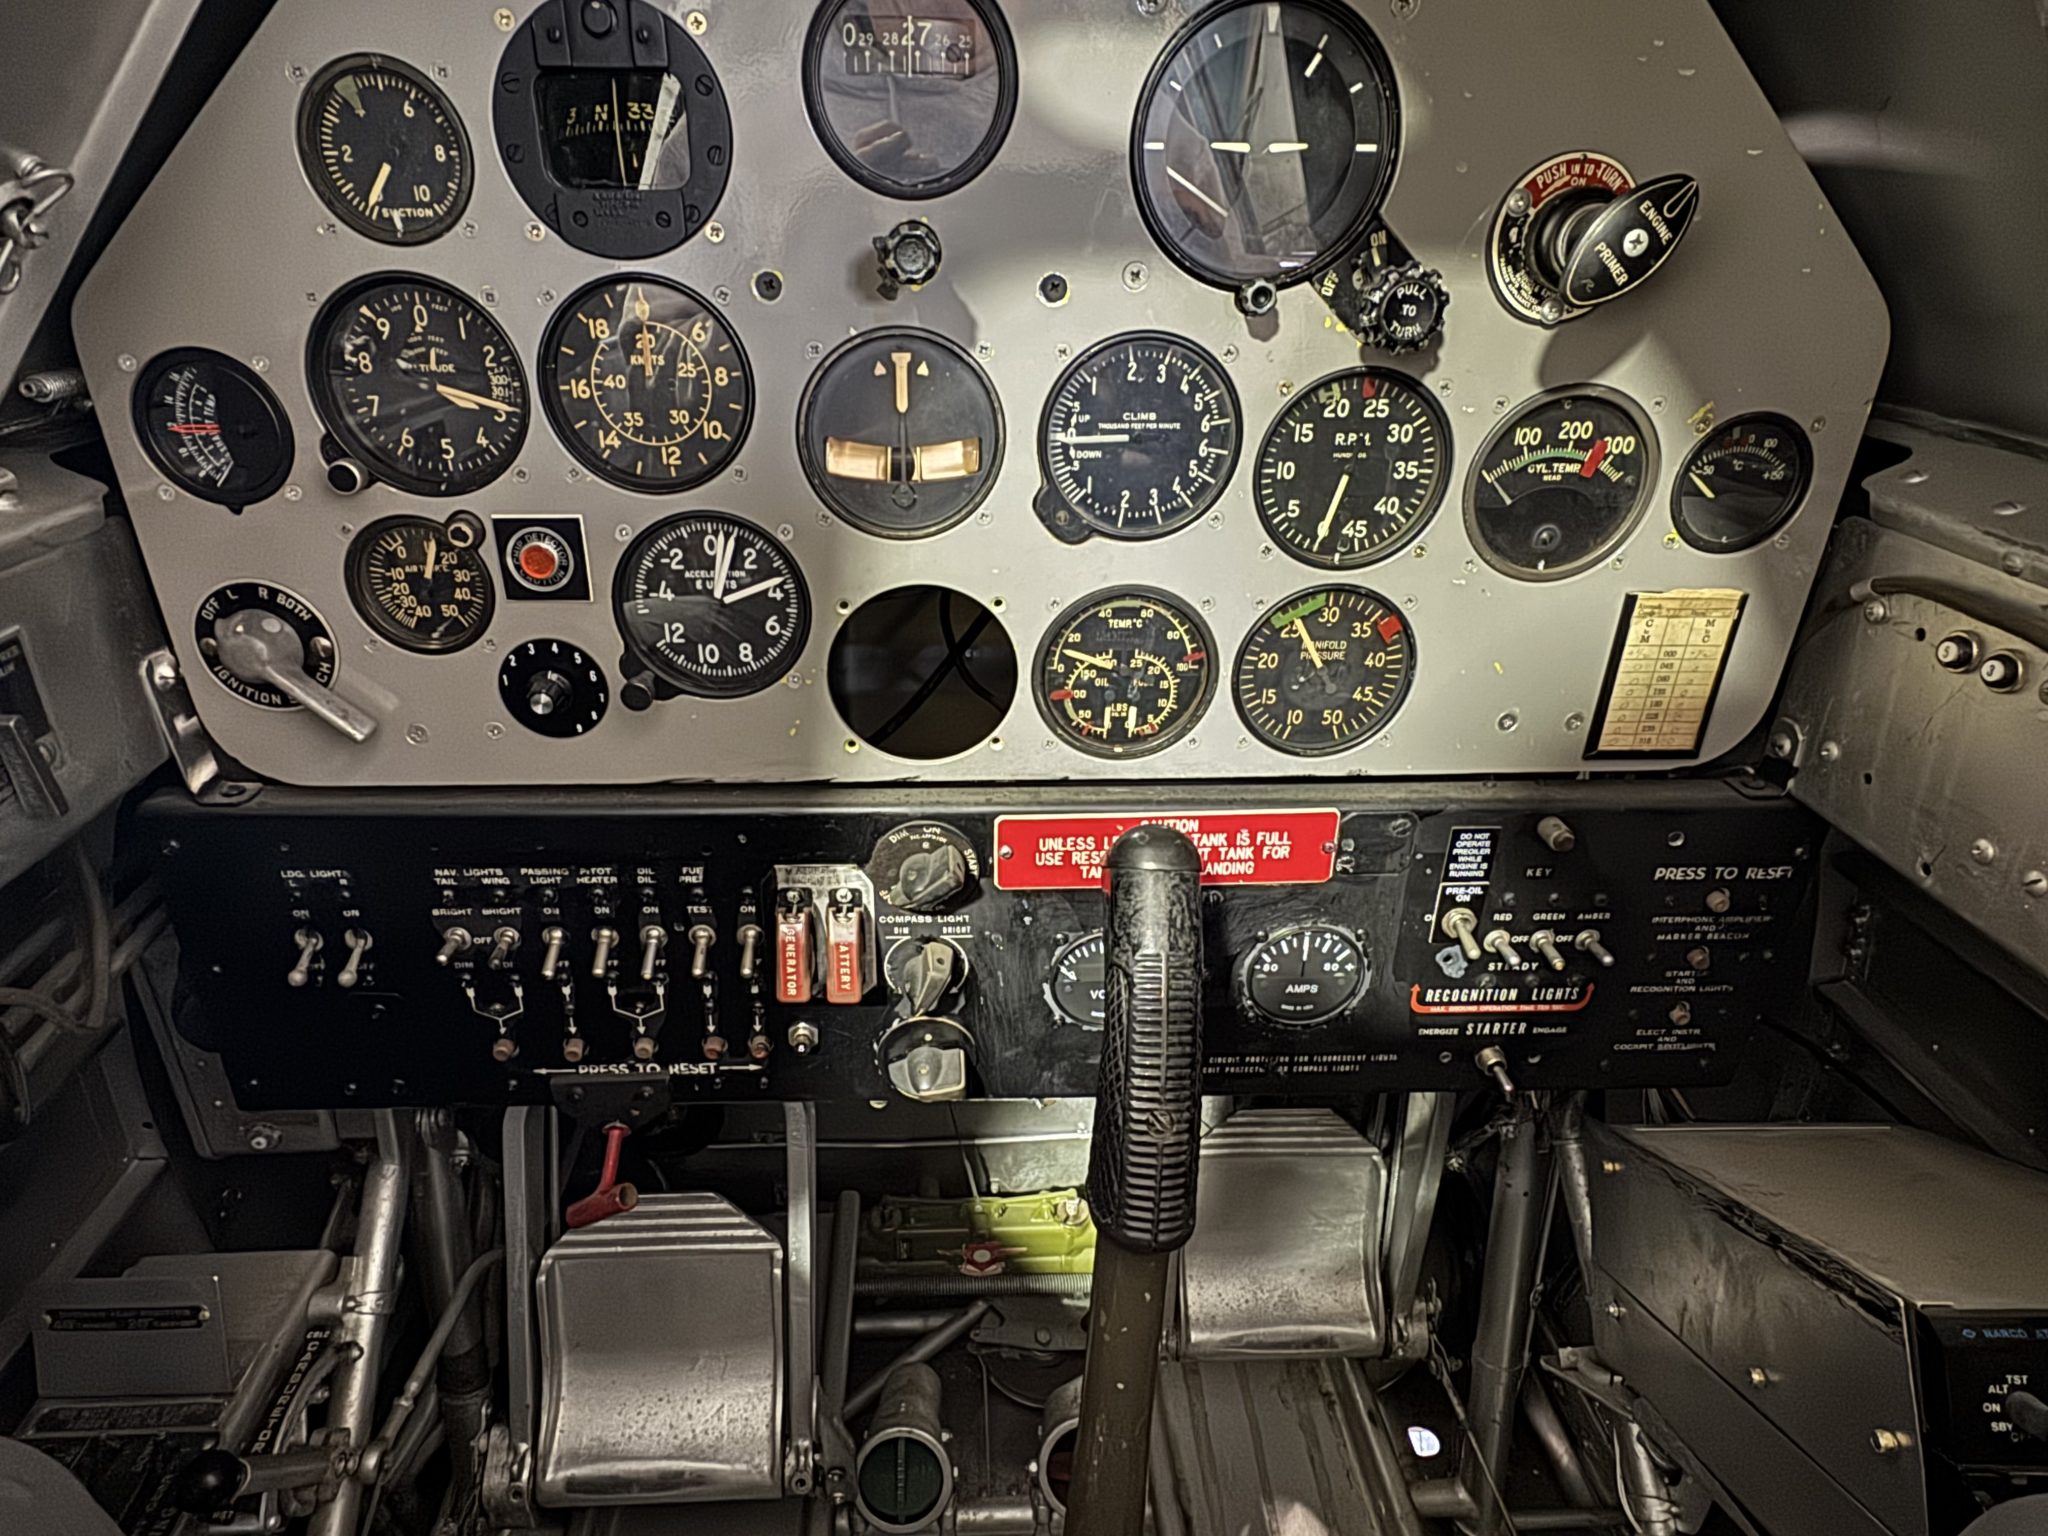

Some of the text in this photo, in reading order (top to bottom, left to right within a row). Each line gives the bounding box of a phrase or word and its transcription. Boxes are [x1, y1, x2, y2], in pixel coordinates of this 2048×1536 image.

[882, 32, 899, 46] 28
[403, 100, 415, 118] 6
[341, 144, 354, 163] 2
[434, 144, 446, 162] 8
[1536, 162, 1625, 192] PUSH IN TURN
[1570, 176, 1587, 187] ON
[413, 184, 431, 202] 10
[381, 207, 434, 218] SUCTION
[1638, 199, 1674, 247] ENGINE
[1369, 229, 1387, 247] ON
[1594, 241, 1630, 288] PRIMER
[1396, 283, 1428, 301] PULL
[413, 304, 428, 327] 0
[1401, 303, 1417, 317] TO
[376, 317, 390, 341] 9
[588, 318, 610, 339] 18
[1390, 320, 1424, 339] TURN
[358, 351, 373, 374] 8
[677, 363, 697, 378] 25
[714, 366, 729, 386] 8
[1127, 362, 1137, 381] 2
[1156, 364, 1166, 384] 3
[569, 378, 591, 399] 16
[603, 374, 626, 389] 40
[1122, 411, 1157, 421] CLIMB
[1323, 398, 1350, 418] 20
[1363, 398, 1390, 418] 25
[623, 412, 644, 427] 35
[669, 410, 690, 426] 30
[1078, 414, 1090, 423] UP
[1098, 422, 1129, 430] THOUSAND
[703, 420, 723, 441] 10
[1294, 423, 1314, 443] 15
[1386, 423, 1414, 443] 30
[1514, 427, 1542, 446] 100
[1558, 421, 1593, 440] 200
[598, 429, 622, 449] 14
[661, 446, 682, 466] 12
[1076, 450, 1102, 459] DOWN
[1188, 459, 1198, 478] 5
[1276, 461, 1295, 480] 10
[1393, 461, 1419, 480] 35
[1121, 490, 1131, 509] 2
[1149, 488, 1158, 506] 3
[1286, 499, 1300, 518] 5
[1374, 496, 1400, 515] 40
[1341, 520, 1367, 538] 45
[524, 531, 569, 567] DETECTOR
[703, 534, 717, 556] 0
[440, 551, 458, 565] 20
[743, 548, 757, 570] 2
[453, 569, 471, 582] 30
[454, 587, 471, 600] 40
[201, 597, 221, 621] OFF
[276, 593, 313, 621] BOTH
[440, 604, 458, 617] 50
[1318, 607, 1340, 623] 30
[664, 622, 686, 644] 12
[765, 615, 780, 636] 6
[1351, 622, 1372, 638] 35
[698, 643, 720, 664] 10
[738, 642, 753, 663] 8
[1364, 652, 1386, 668] 40
[508, 655, 517, 667] 2
[1257, 653, 1278, 669] 20
[213, 665, 282, 705] IGNITION
[1094, 678, 1109, 687] OIL
[1262, 688, 1276, 704] 15
[1352, 686, 1374, 701] 45
[1111, 703, 1128, 712] LBS
[1287, 709, 1303, 725] 10
[1321, 709, 1343, 725] 50
[888, 828, 909, 844] DIM
[1039, 836, 1096, 852] UNLESS
[1191, 833, 1227, 847] TANK
[1236, 831, 1250, 846] IS
[1256, 831, 1292, 845] FULL
[1455, 840, 1492, 848] OPERATE
[1474, 832, 1491, 840] NOT
[1035, 851, 1064, 866] USE
[1218, 846, 1254, 861] TANK
[1262, 845, 1290, 860] FOR
[1457, 855, 1483, 863] WHILE
[463, 868, 504, 877] LIGHTS
[520, 868, 569, 876] PASSING
[580, 867, 613, 875] PITOT
[637, 867, 656, 875] OIL
[1448, 870, 1485, 878] RUNNING
[1526, 868, 1553, 877] KEY
[1654, 865, 1794, 881] PRESS TO RESET
[434, 878, 458, 886] TAIL
[481, 877, 511, 885] WING
[530, 876, 562, 884] LIGHT
[576, 876, 618, 884] HEATER
[1445, 886, 1484, 895] PRE-OIL
[1455, 894, 1471, 903] ON
[431, 908, 473, 916] BRIGHT
[481, 907, 522, 916] BRIGHT
[593, 906, 610, 915] ON
[642, 906, 659, 914] ON
[739, 905, 757, 913] ON
[1493, 913, 1513, 921] RED
[1532, 912, 1566, 921] GREEN
[1576, 912, 1611, 920] AMBER
[879, 914, 970, 924] COMPASS LIGHT
[893, 926, 909, 934] DIM
[942, 926, 971, 934] BRIGHT
[1694, 924, 1716, 932] AND
[473, 936, 493, 944] OFF
[1510, 935, 1530, 944] OFF
[1555, 935, 1574, 943] OFF
[1656, 932, 1750, 941] MARKER BEACON
[454, 961, 474, 969] DIM
[784, 928, 797, 997] GENERATOR
[839, 941, 852, 991] ATTERY
[1285, 984, 1319, 994] AMPS
[1425, 987, 1580, 1003] RECOGNITION LIGHTS
[1630, 985, 1696, 993] RECOGNITION
[1418, 1022, 1568, 1036] ENERGIZE STARTER ENGAGE
[578, 1062, 718, 1075] PRESS RESET
[2005, 1374, 2028, 1385] TST
[251, 1340, 320, 1454] CARBURETOR
[1987, 1384, 2009, 1394] ALT
[1982, 1402, 2001, 1413] ON
[1991, 1421, 2014, 1432] SBY
